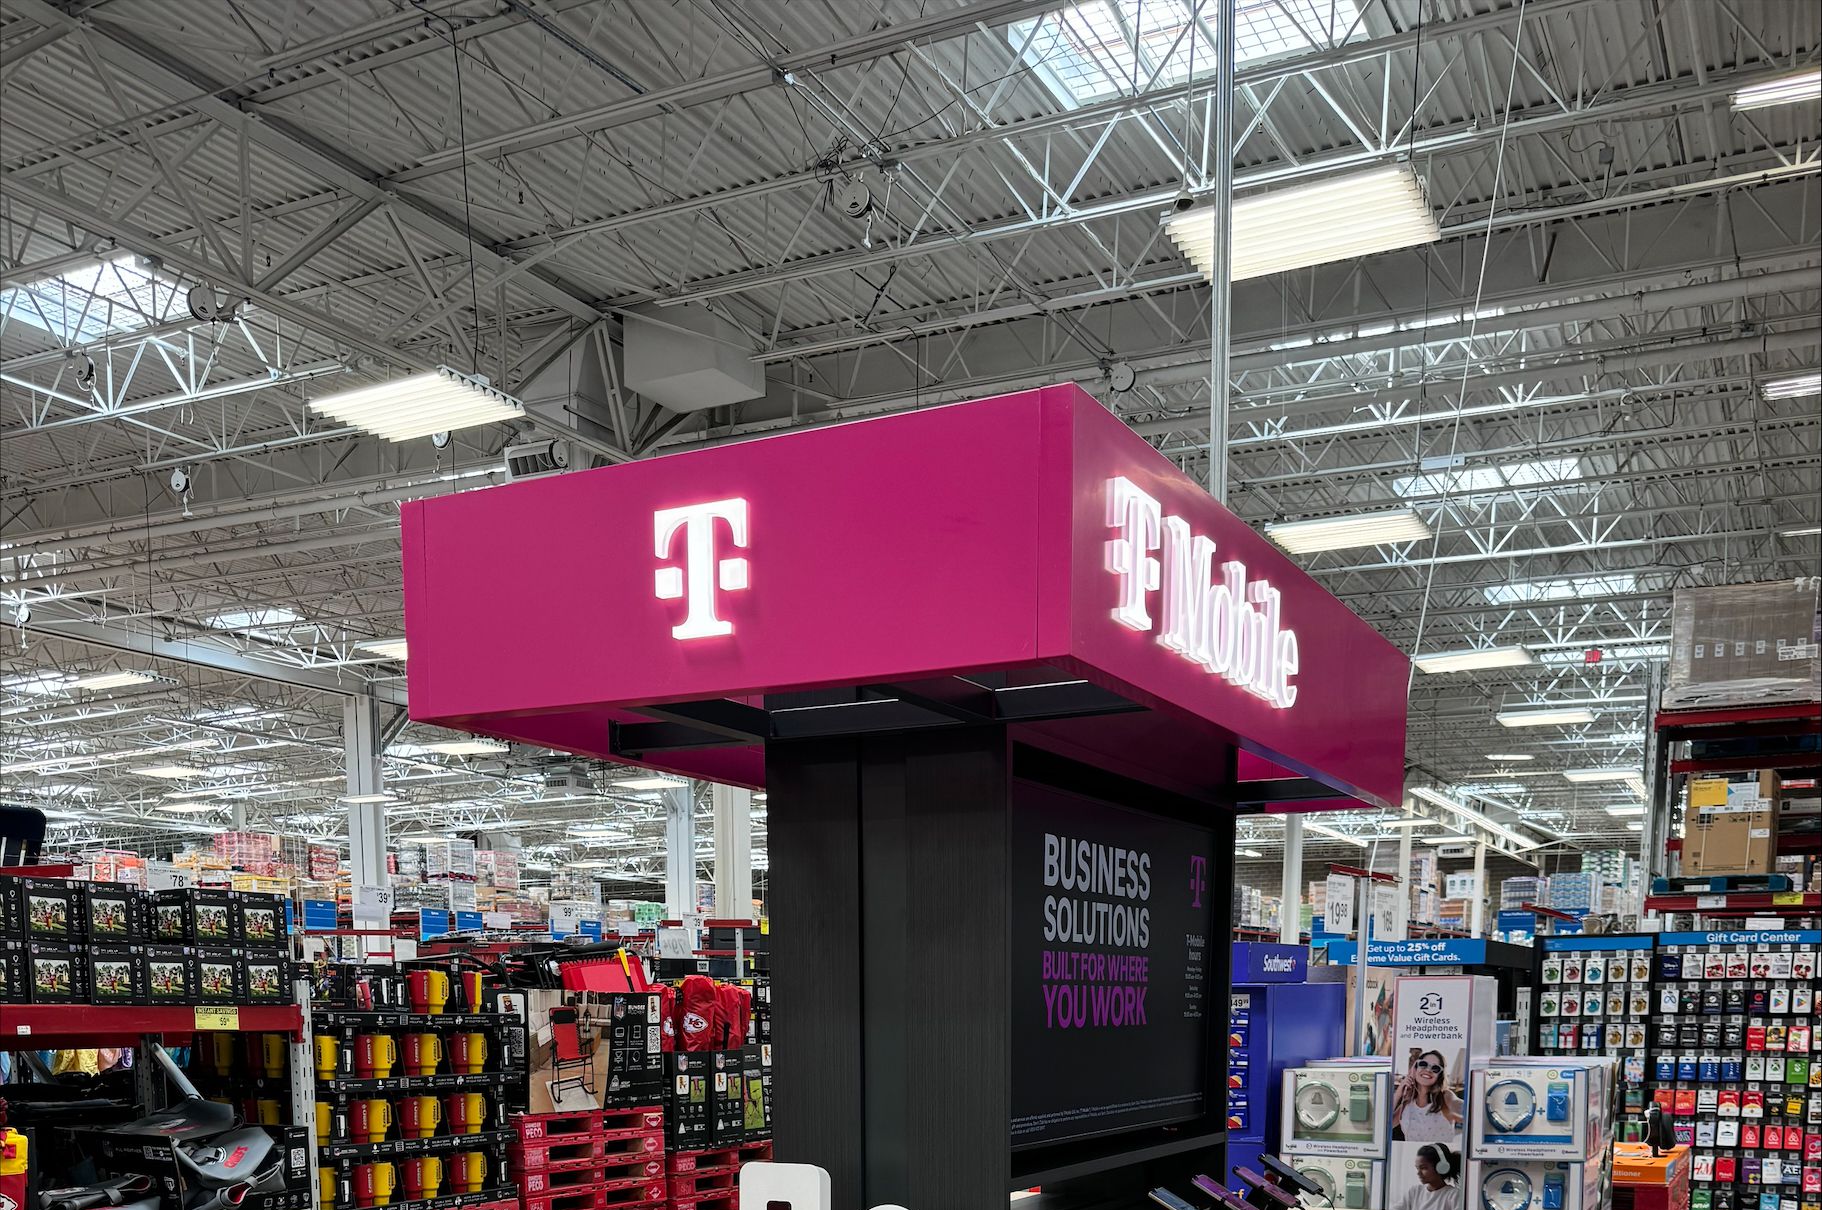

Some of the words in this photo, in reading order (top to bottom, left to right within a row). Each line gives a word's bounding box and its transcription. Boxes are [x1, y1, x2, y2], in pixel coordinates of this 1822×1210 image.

[653, 496, 748, 641] T
[1157, 515, 1300, 709] Mobile
[1043, 832, 1150, 901] BUSINESS
[1189, 854, 1207, 908] T
[1043, 894, 1150, 949] SOLUTIONS
[1706, 932, 1728, 943] Gift
[1729, 932, 1757, 943] Card
[1760, 932, 1802, 943] Center
[1350, 954, 1387, 963] Eeme
[1388, 953, 1412, 962] Value
[1413, 953, 1430, 961] Gift
[1431, 953, 1461, 961] Cards.
[1367, 944, 1383, 952] Get
[1383, 945, 1396, 955] up
[1396, 944, 1406, 952] to
[1406, 942, 1429, 952] 25%
[1430, 942, 1446, 951] off
[1042, 950, 1080, 980] BUILT
[1080, 952, 1105, 981] FOR
[1107, 954, 1149, 982] WHERE
[1262, 953, 1292, 972] Southwest
[1042, 984, 1087, 1029] YOU
[1090, 985, 1148, 1027] WORK
[1405, 1024, 1459, 1033] Headphones
[1414, 1017, 1451, 1025] Wireless
[1413, 1032, 1463, 1040] Powerbank
[525, 1129, 543, 1139] PECO
